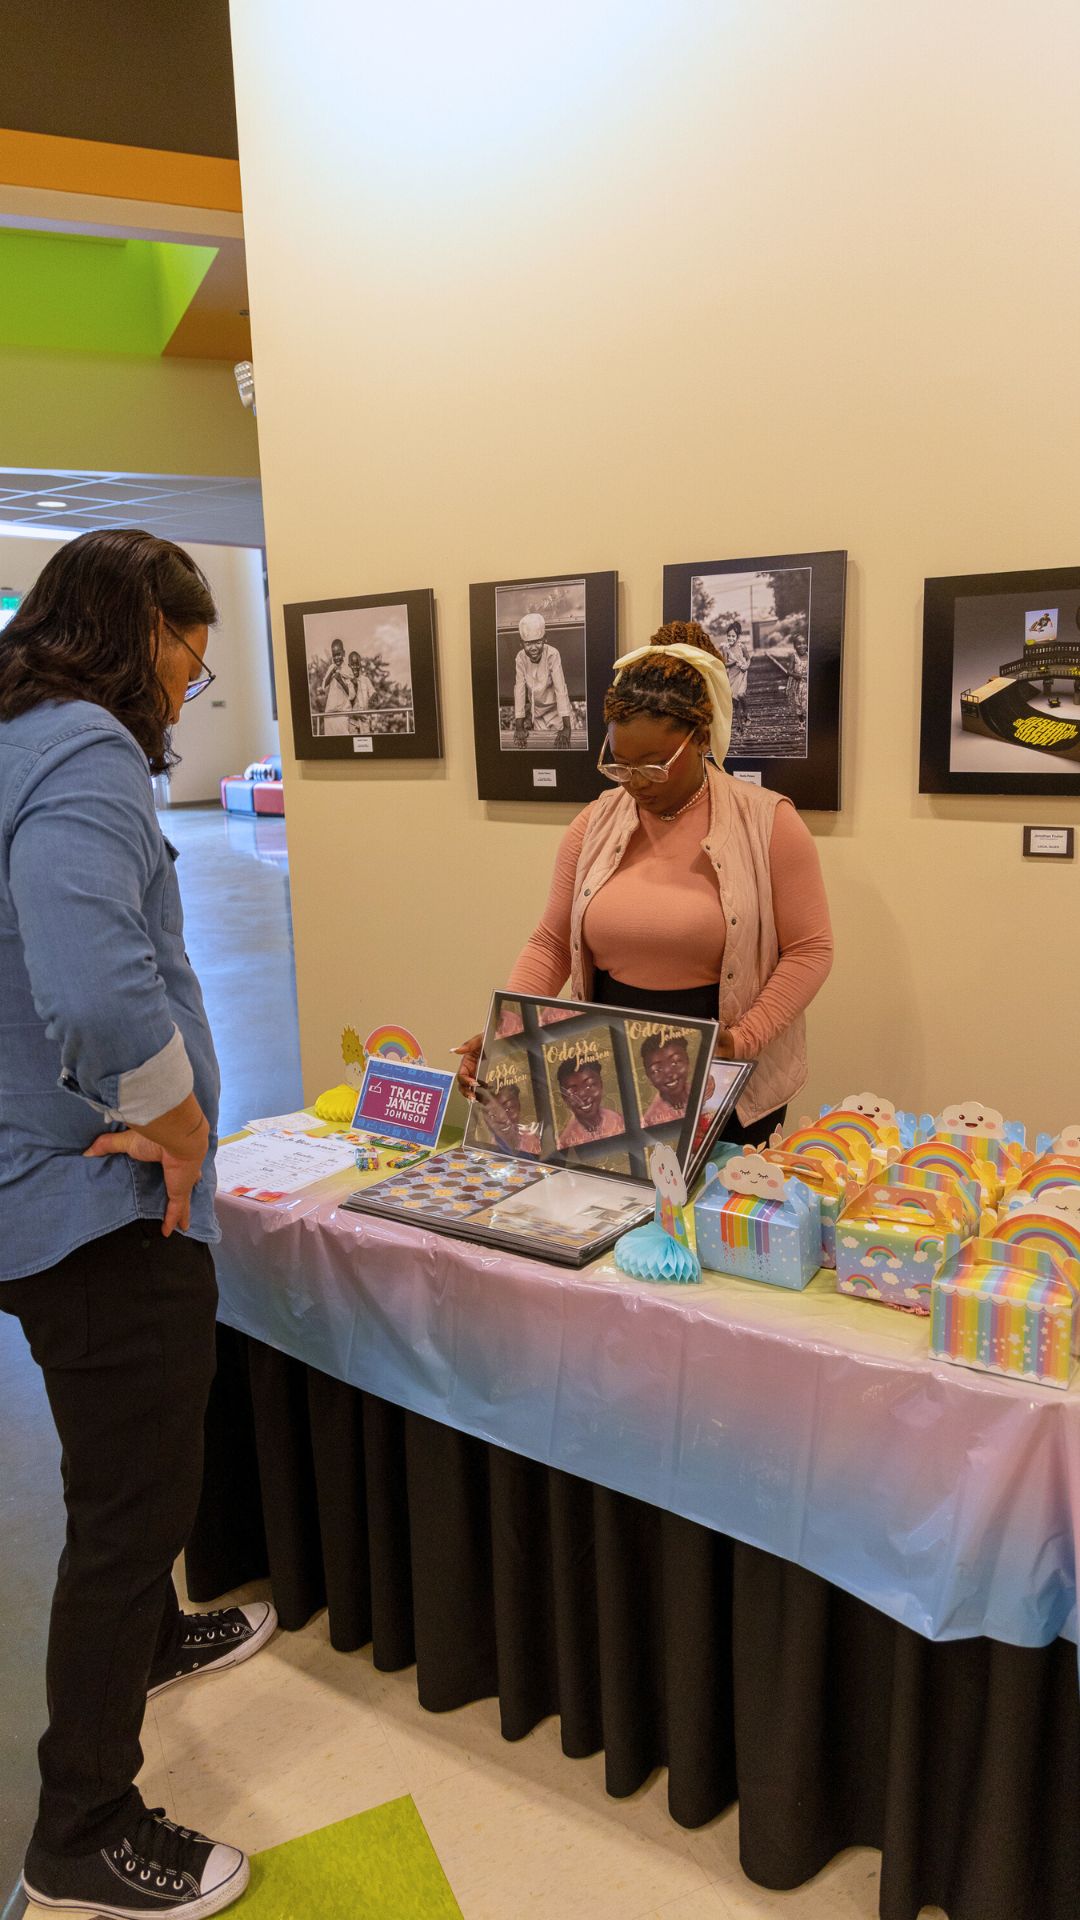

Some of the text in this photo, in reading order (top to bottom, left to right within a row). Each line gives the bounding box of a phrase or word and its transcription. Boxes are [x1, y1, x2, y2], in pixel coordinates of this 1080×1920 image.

[547, 1040, 599, 1064] Odessa
[575, 1049, 610, 1072] Johnson
[495, 1073, 527, 1095] Johnson
[390, 1085, 433, 1104] TRACIE
[384, 1108, 426, 1125] JOHNSON
[386, 1097, 430, 1116] JA'NEICE
